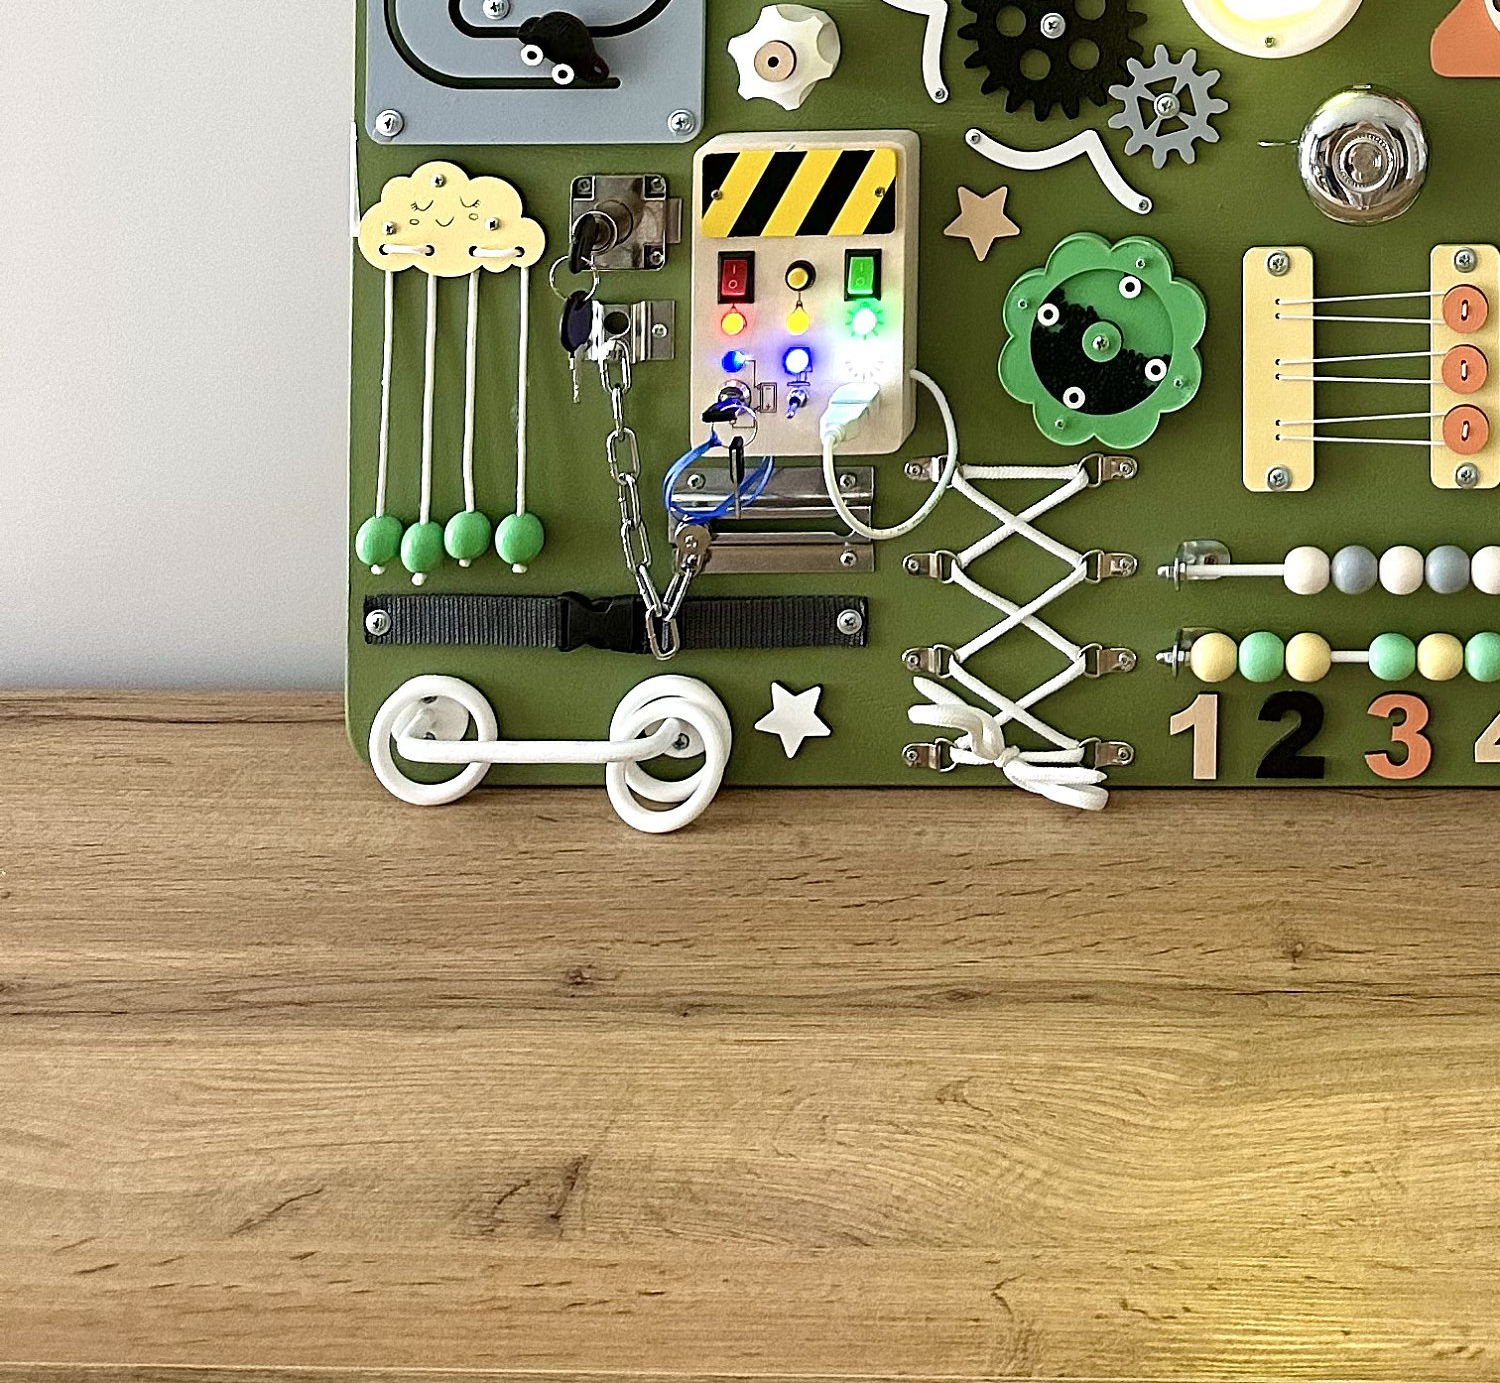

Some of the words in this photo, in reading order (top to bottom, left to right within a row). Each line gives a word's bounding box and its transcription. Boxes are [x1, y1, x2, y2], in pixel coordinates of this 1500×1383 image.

[1169, 691, 1218, 780] 1
[1256, 690, 1325, 779] 2
[1364, 691, 1434, 780] 3
